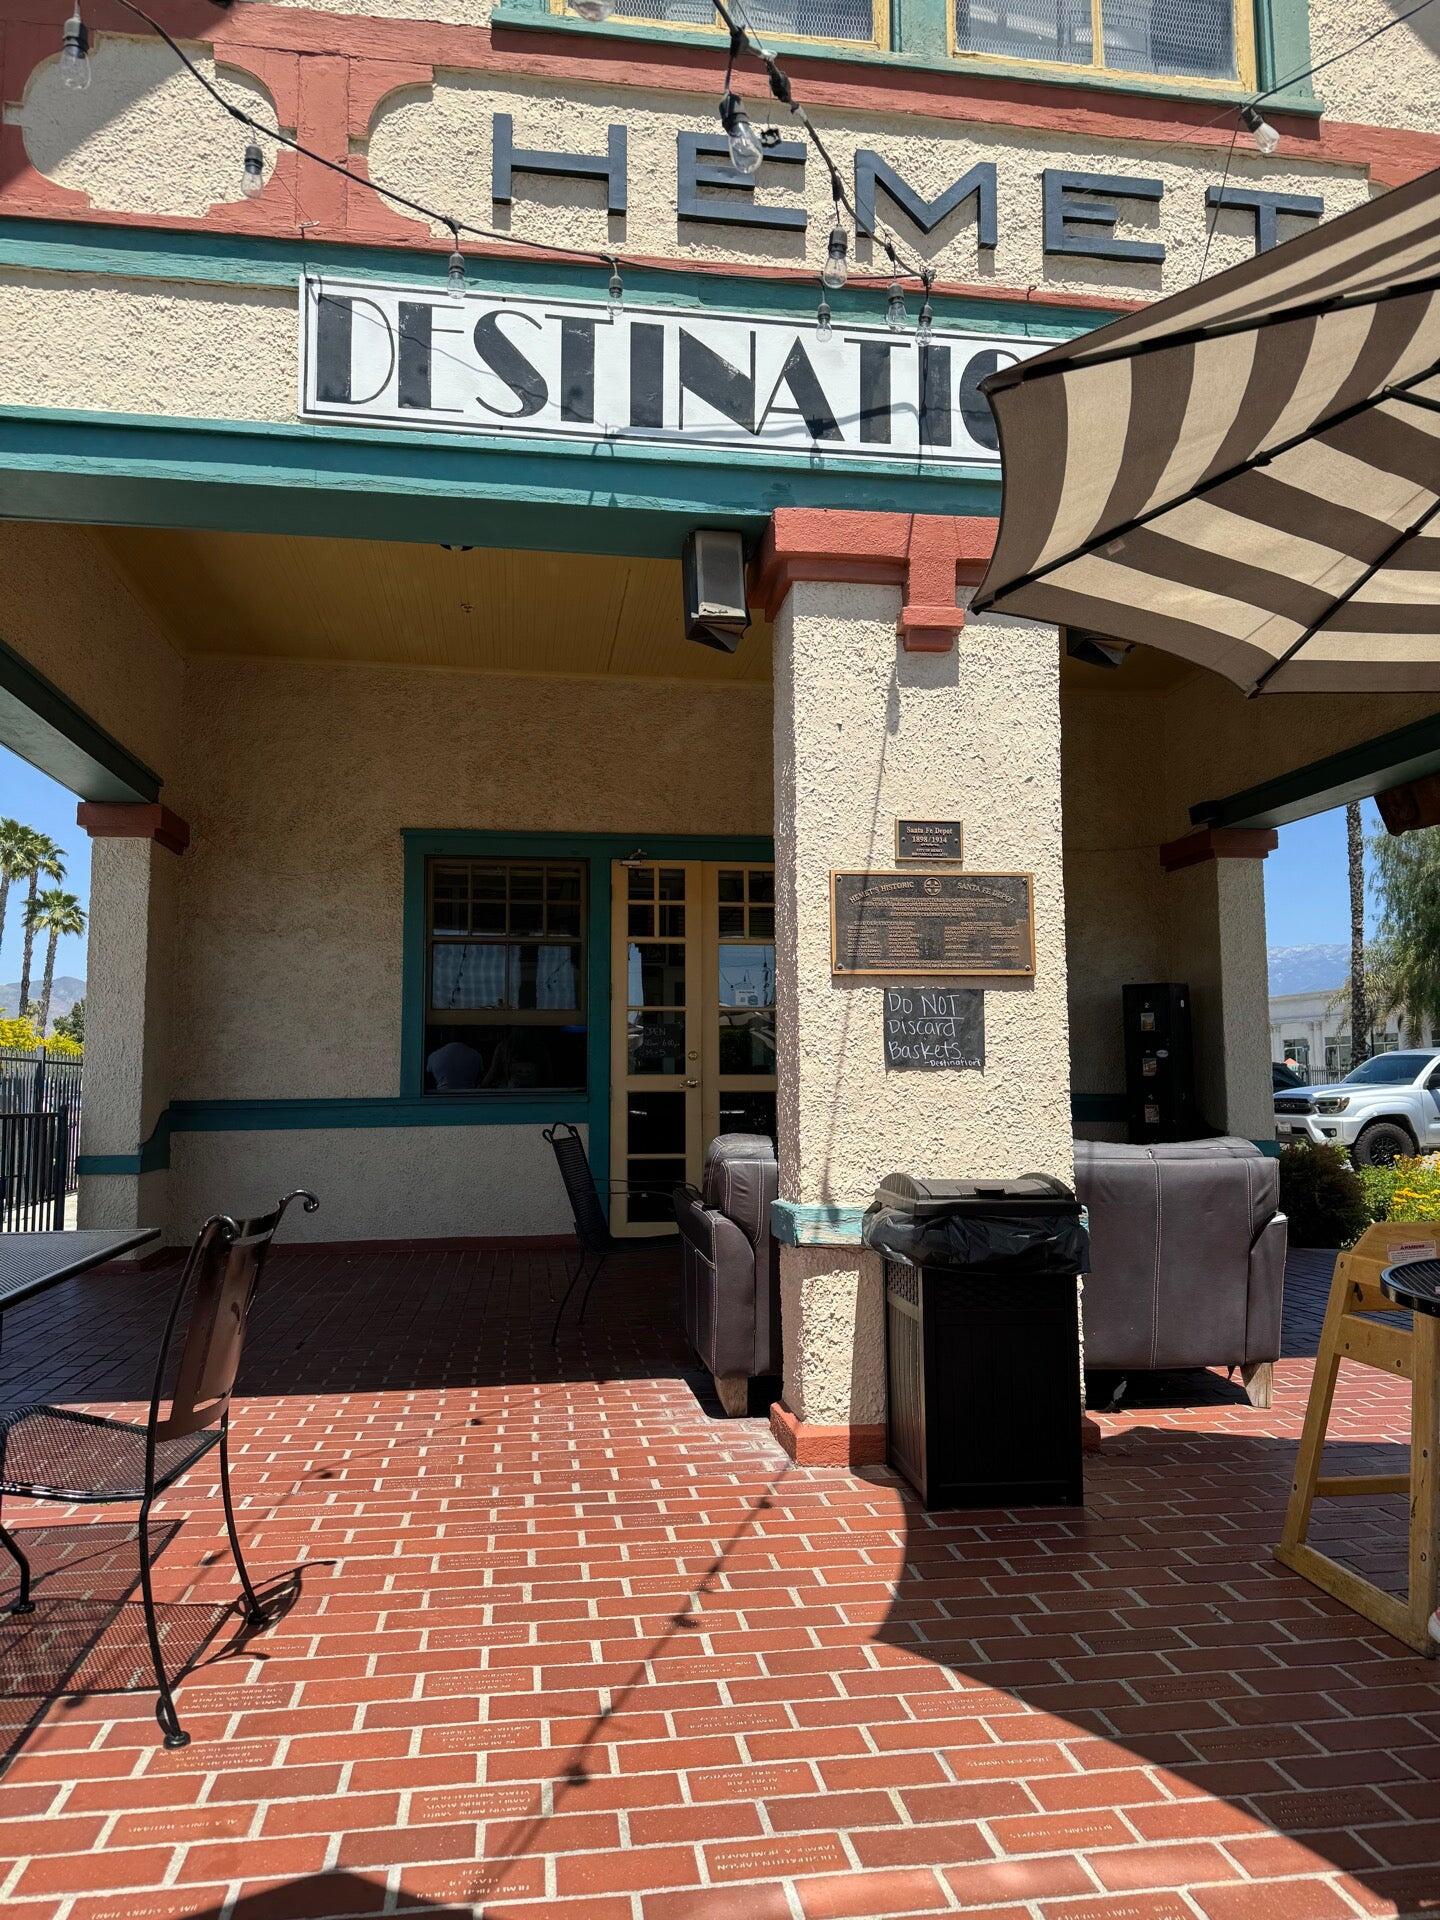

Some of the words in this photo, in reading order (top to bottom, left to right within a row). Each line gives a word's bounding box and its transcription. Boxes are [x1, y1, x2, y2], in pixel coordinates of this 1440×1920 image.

[492, 112, 1325, 264] HEMET
[906, 826, 924, 834] Santa
[935, 827, 953, 836] Depot
[912, 835, 947, 844] 1898/1914
[848, 886, 880, 904] HEMET'S
[880, 881, 914, 892] HISTORIC
[957, 882, 980, 892] SANTA
[982, 886, 991, 895] FE
[992, 889, 1017, 904] DEPOT
[888, 992, 913, 1014] Do
[921, 993, 960, 1016] NOT
[887, 1016, 956, 1038] Discard
